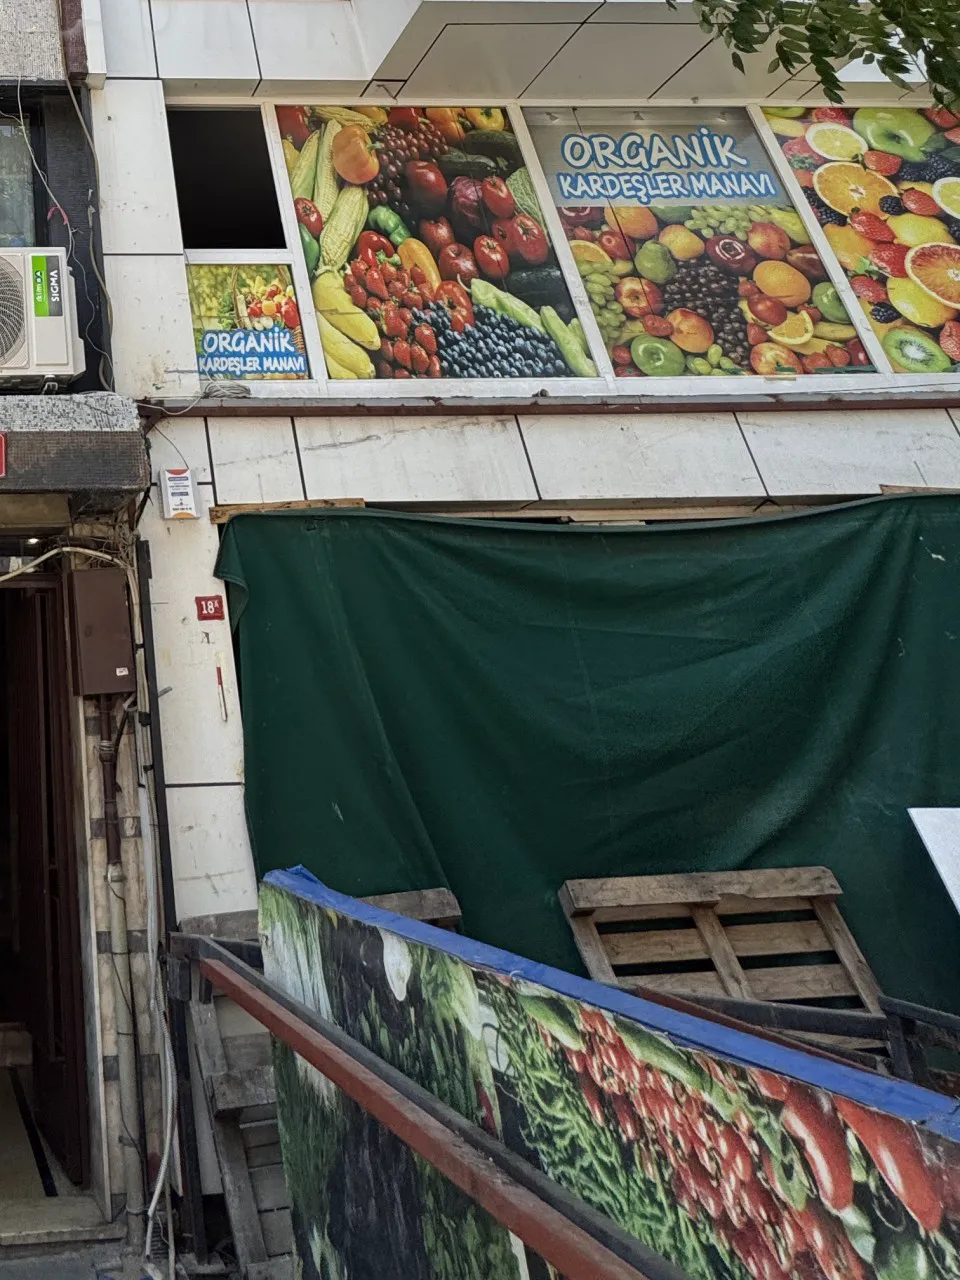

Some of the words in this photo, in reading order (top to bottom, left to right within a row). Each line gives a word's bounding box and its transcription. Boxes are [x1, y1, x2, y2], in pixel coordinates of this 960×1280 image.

[562, 127, 748, 170] ORGANİK
[558, 172, 691, 204] KARDEŞLER
[689, 172, 776, 197] MANAVI
[49, 269, 60, 302] SIGMA
[203, 326, 295, 354] ORGANİK
[199, 356, 261, 376] KARDEŞLER
[263, 356, 305, 372] MANAVI
